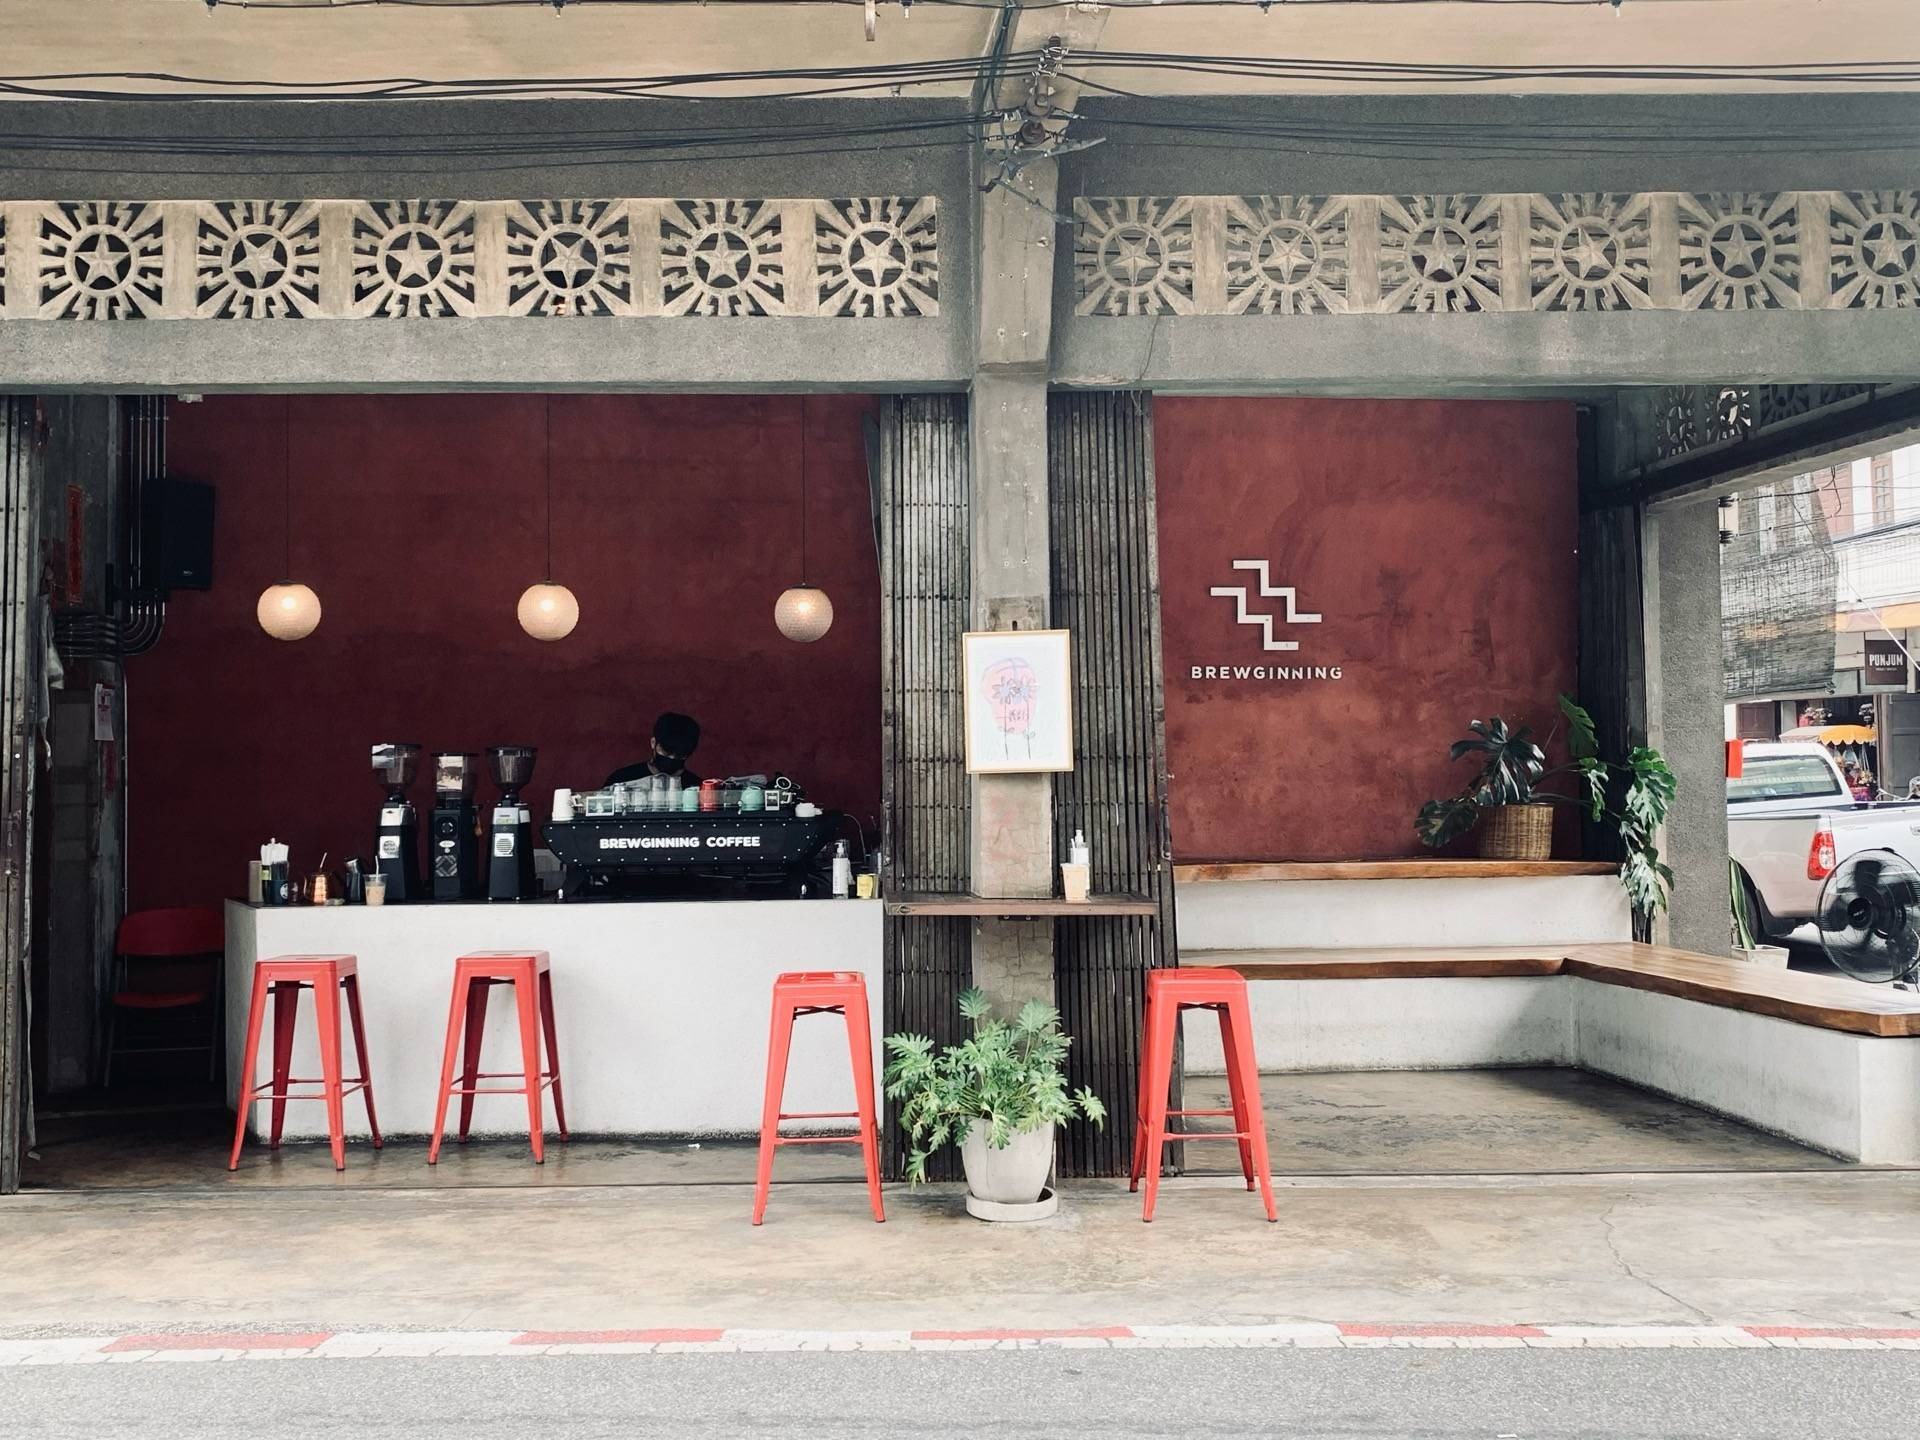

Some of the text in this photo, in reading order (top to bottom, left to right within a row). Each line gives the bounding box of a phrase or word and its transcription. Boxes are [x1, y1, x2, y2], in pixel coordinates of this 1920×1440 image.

[1869, 654, 1903, 666] PUNJUM
[1191, 666, 1342, 680] BREWGINNING
[599, 836, 761, 849] BREWGINNING COFFEE
